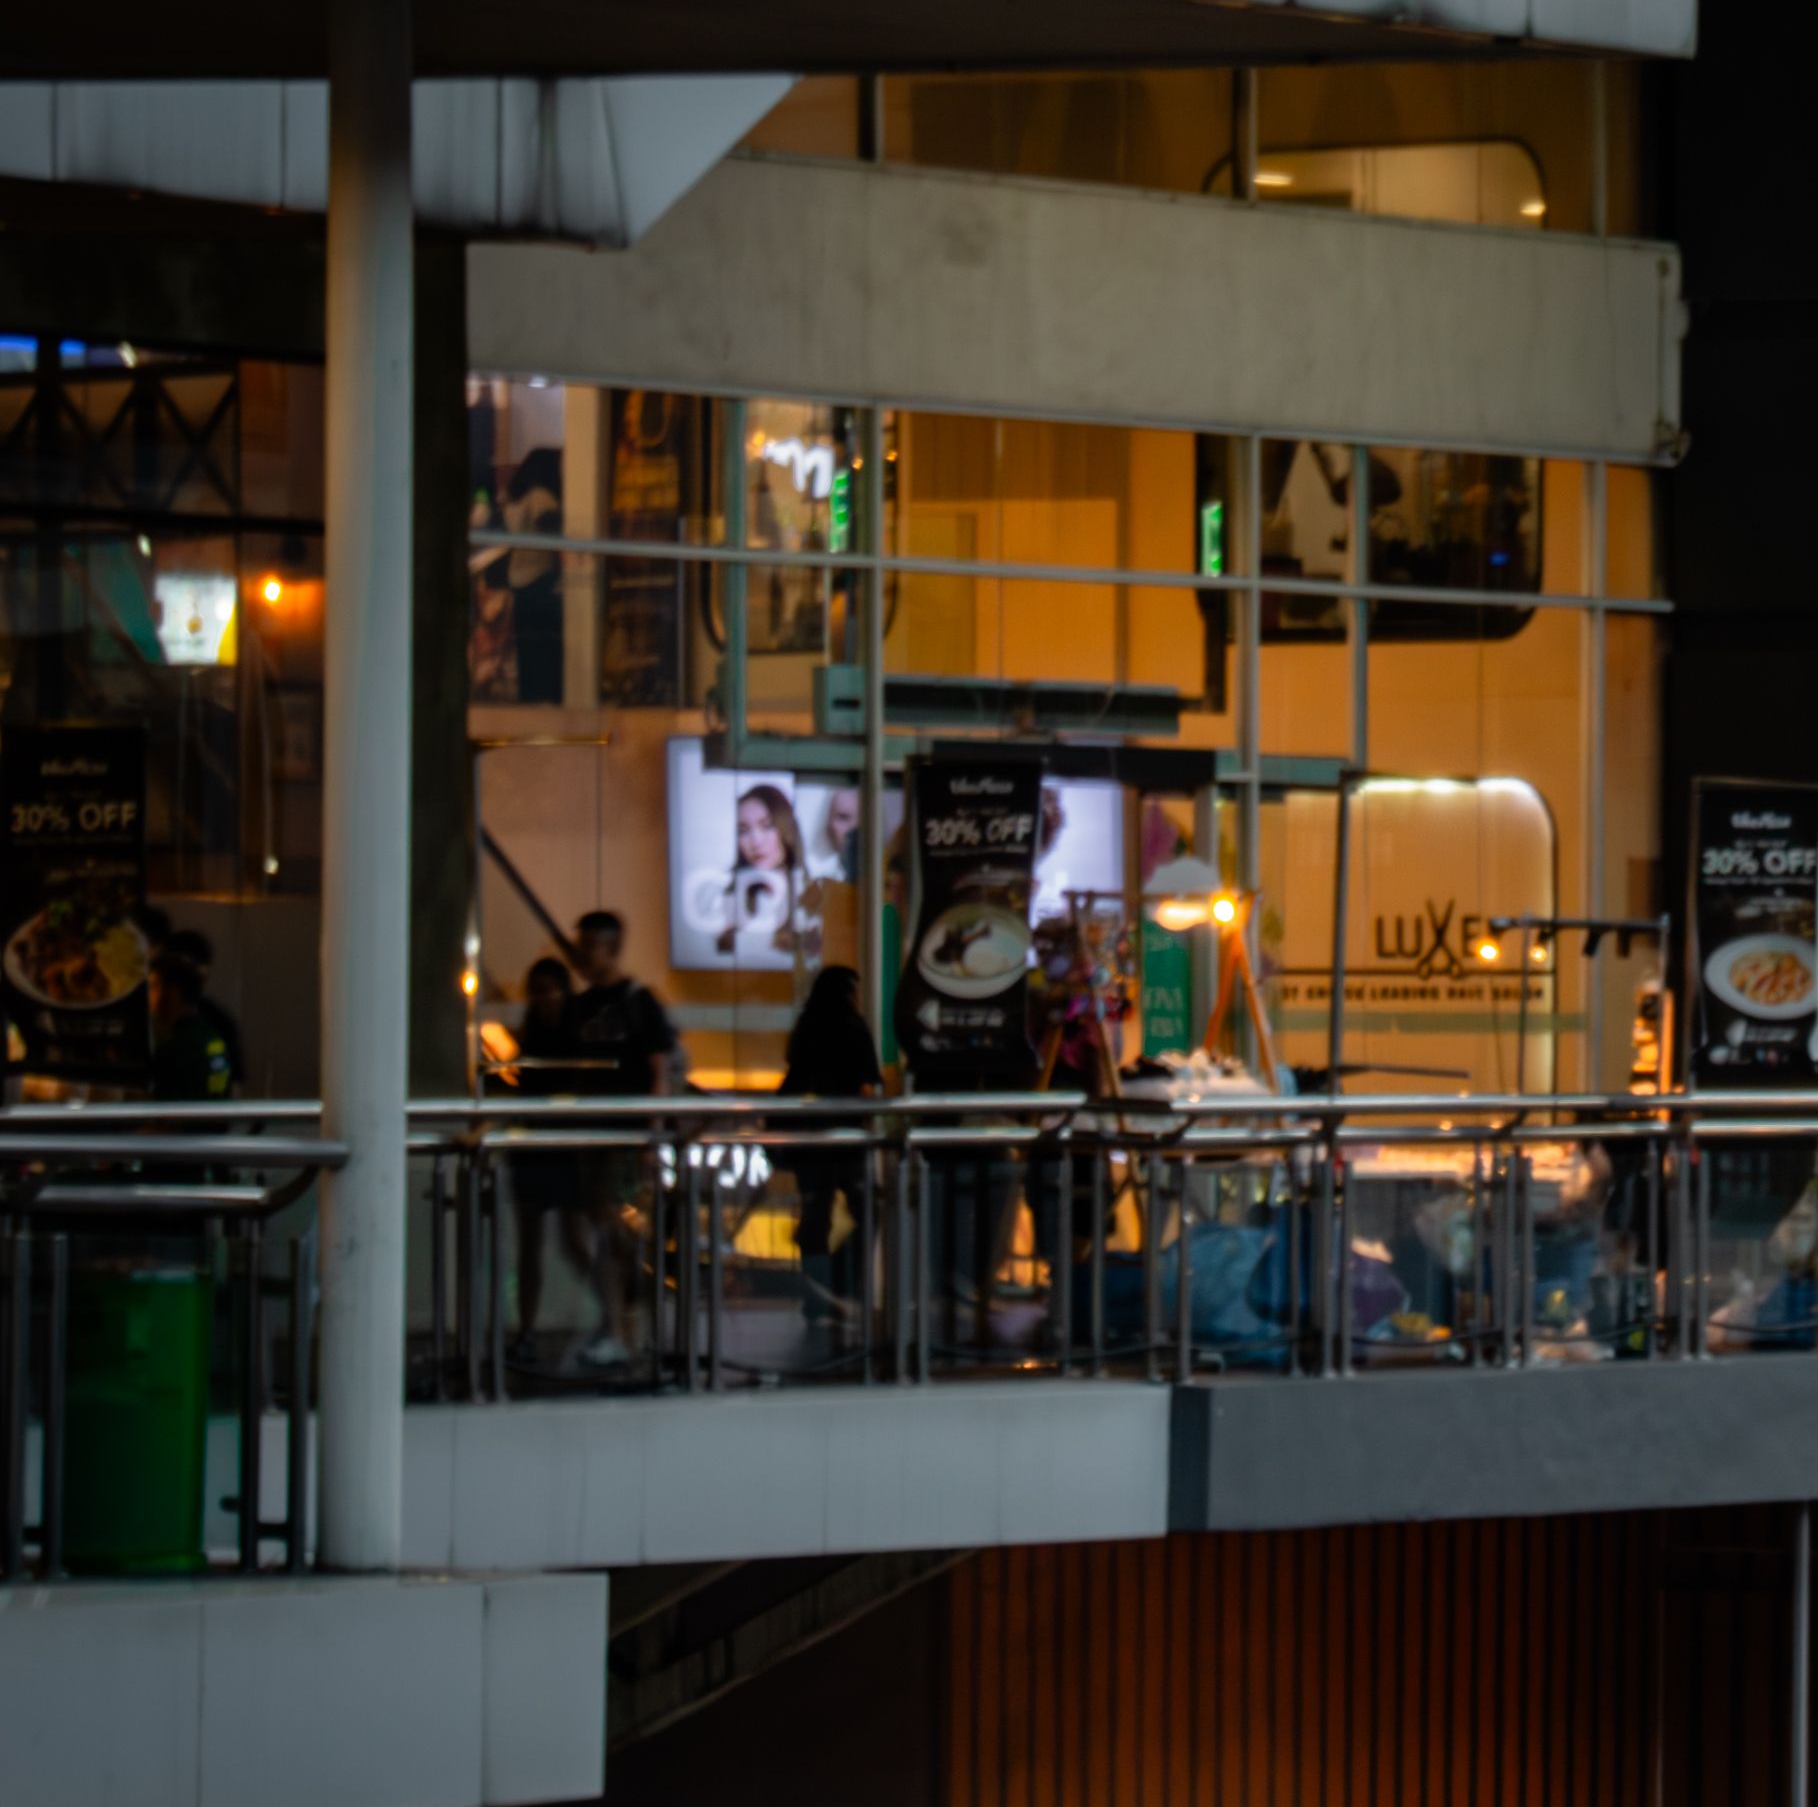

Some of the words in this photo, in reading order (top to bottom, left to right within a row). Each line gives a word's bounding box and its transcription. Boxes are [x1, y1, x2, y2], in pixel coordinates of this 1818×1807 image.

[13, 804, 70, 834] 30%
[78, 801, 138, 833] OFF
[925, 816, 981, 847] 30%
[985, 813, 1034, 843] OFF
[1702, 847, 1759, 876] 30%
[1763, 847, 1818, 876] OFF
